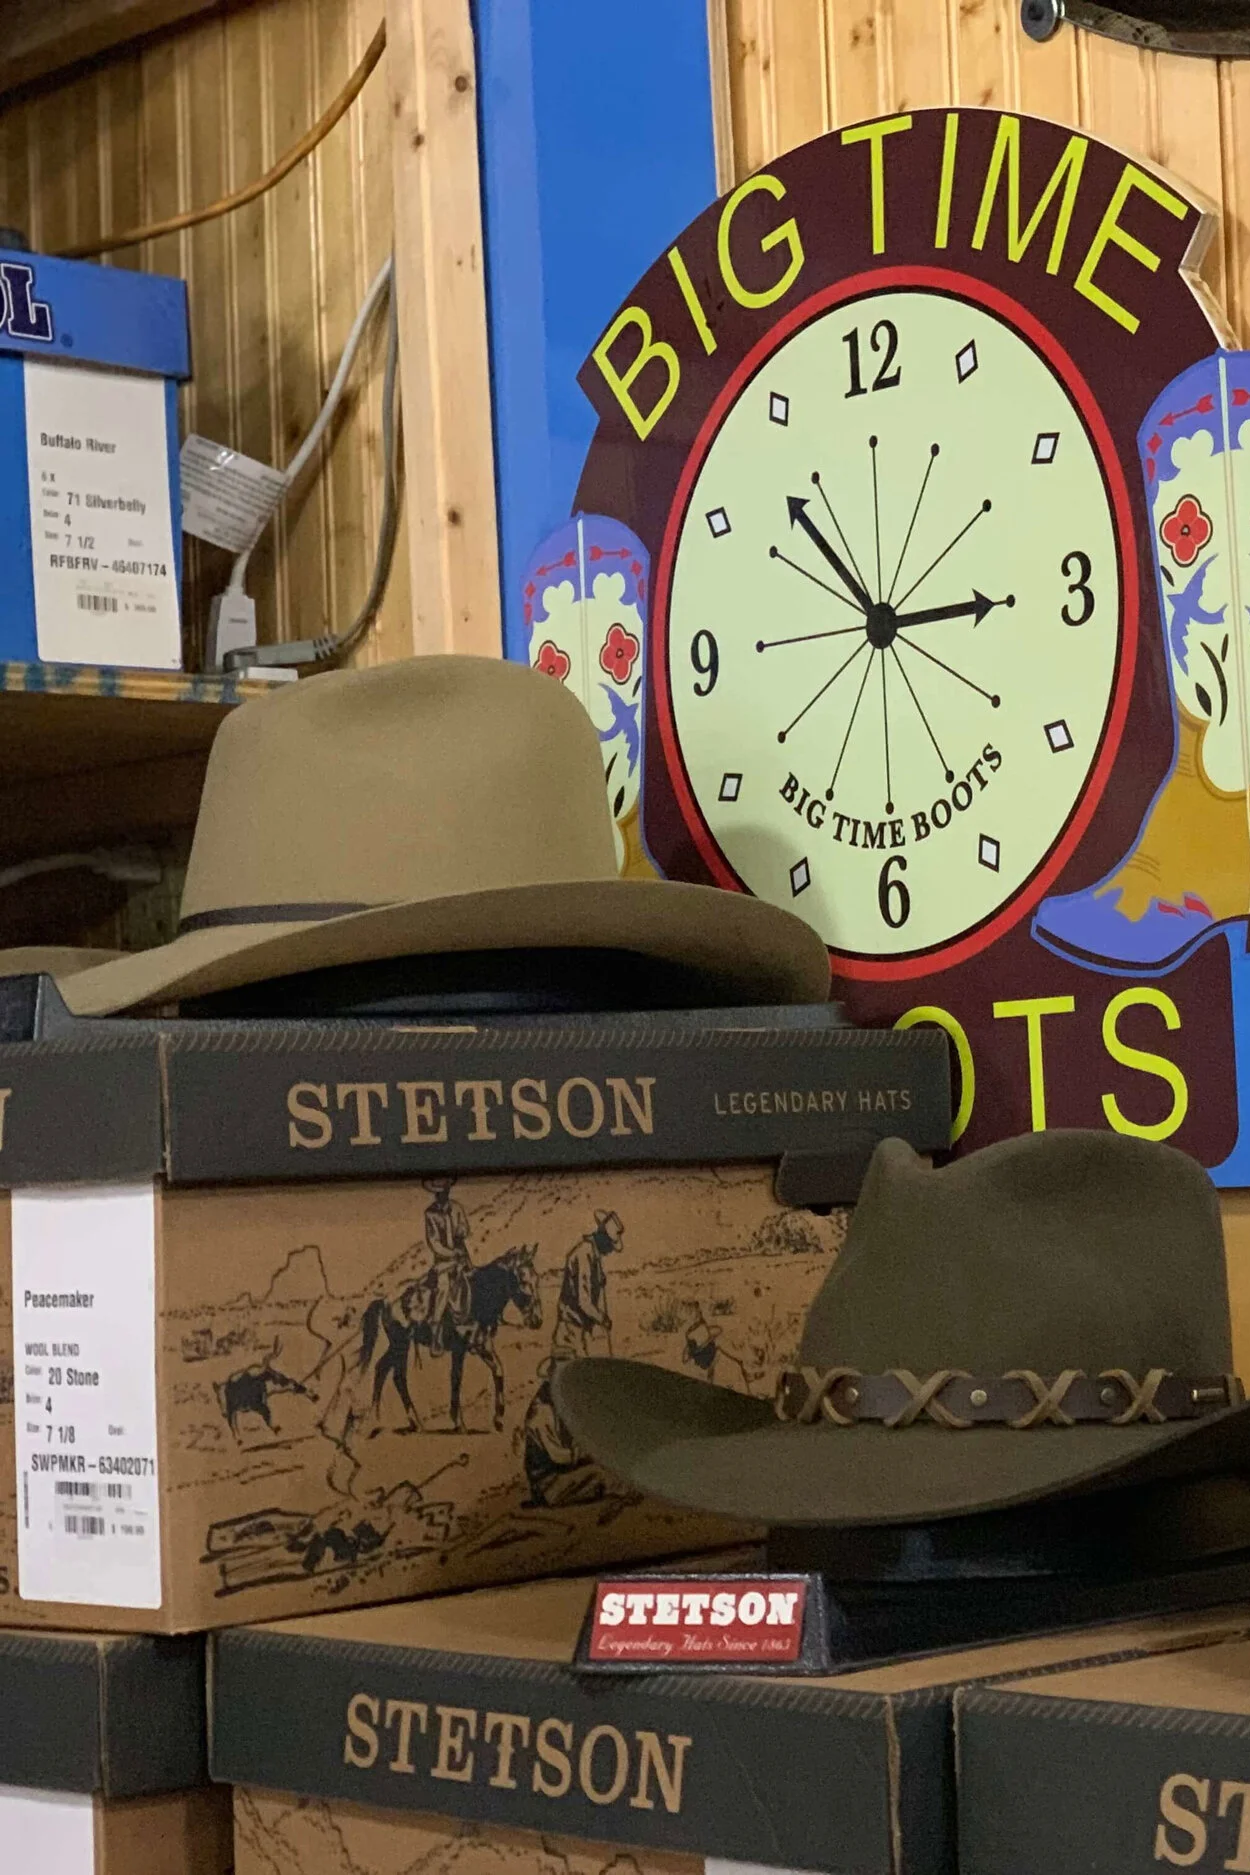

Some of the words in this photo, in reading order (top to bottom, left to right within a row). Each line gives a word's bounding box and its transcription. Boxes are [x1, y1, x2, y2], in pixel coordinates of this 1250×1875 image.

[593, 174, 806, 440] BIG
[841, 113, 1189, 333] TIME
[0, 263, 53, 341] L
[843, 319, 902, 399] 12
[40, 432, 82, 450] Buffalo
[86, 438, 117, 454] River
[67, 492, 81, 506] 71
[85, 494, 146, 515] Silverbelly
[65, 534, 72, 547] 7
[78, 536, 95, 549] 1/2
[1061, 551, 1095, 627] 3
[691, 630, 719, 696] 9
[779, 771, 827, 829] BIG
[832, 811, 906, 849] TIME
[910, 742, 1003, 842] BOOTS
[878, 855, 911, 929] 6
[287, 1077, 656, 1149] STETSON
[714, 1090, 847, 1115] LEGENDARY
[859, 1089, 912, 1112] HATS
[24, 1290, 95, 1309] Peacemaker
[48, 1366, 62, 1387] 20
[66, 1367, 99, 1387] Stone
[45, 1395, 53, 1413] 4
[46, 1425, 53, 1443] 7
[58, 1425, 76, 1444] 1/8
[599, 1592, 799, 1627] STETSON
[598, 1633, 673, 1656] Legendary
[681, 1633, 713, 1651] Hats
[717, 1633, 758, 1651] Since
[344, 1693, 693, 1813] STETSON
